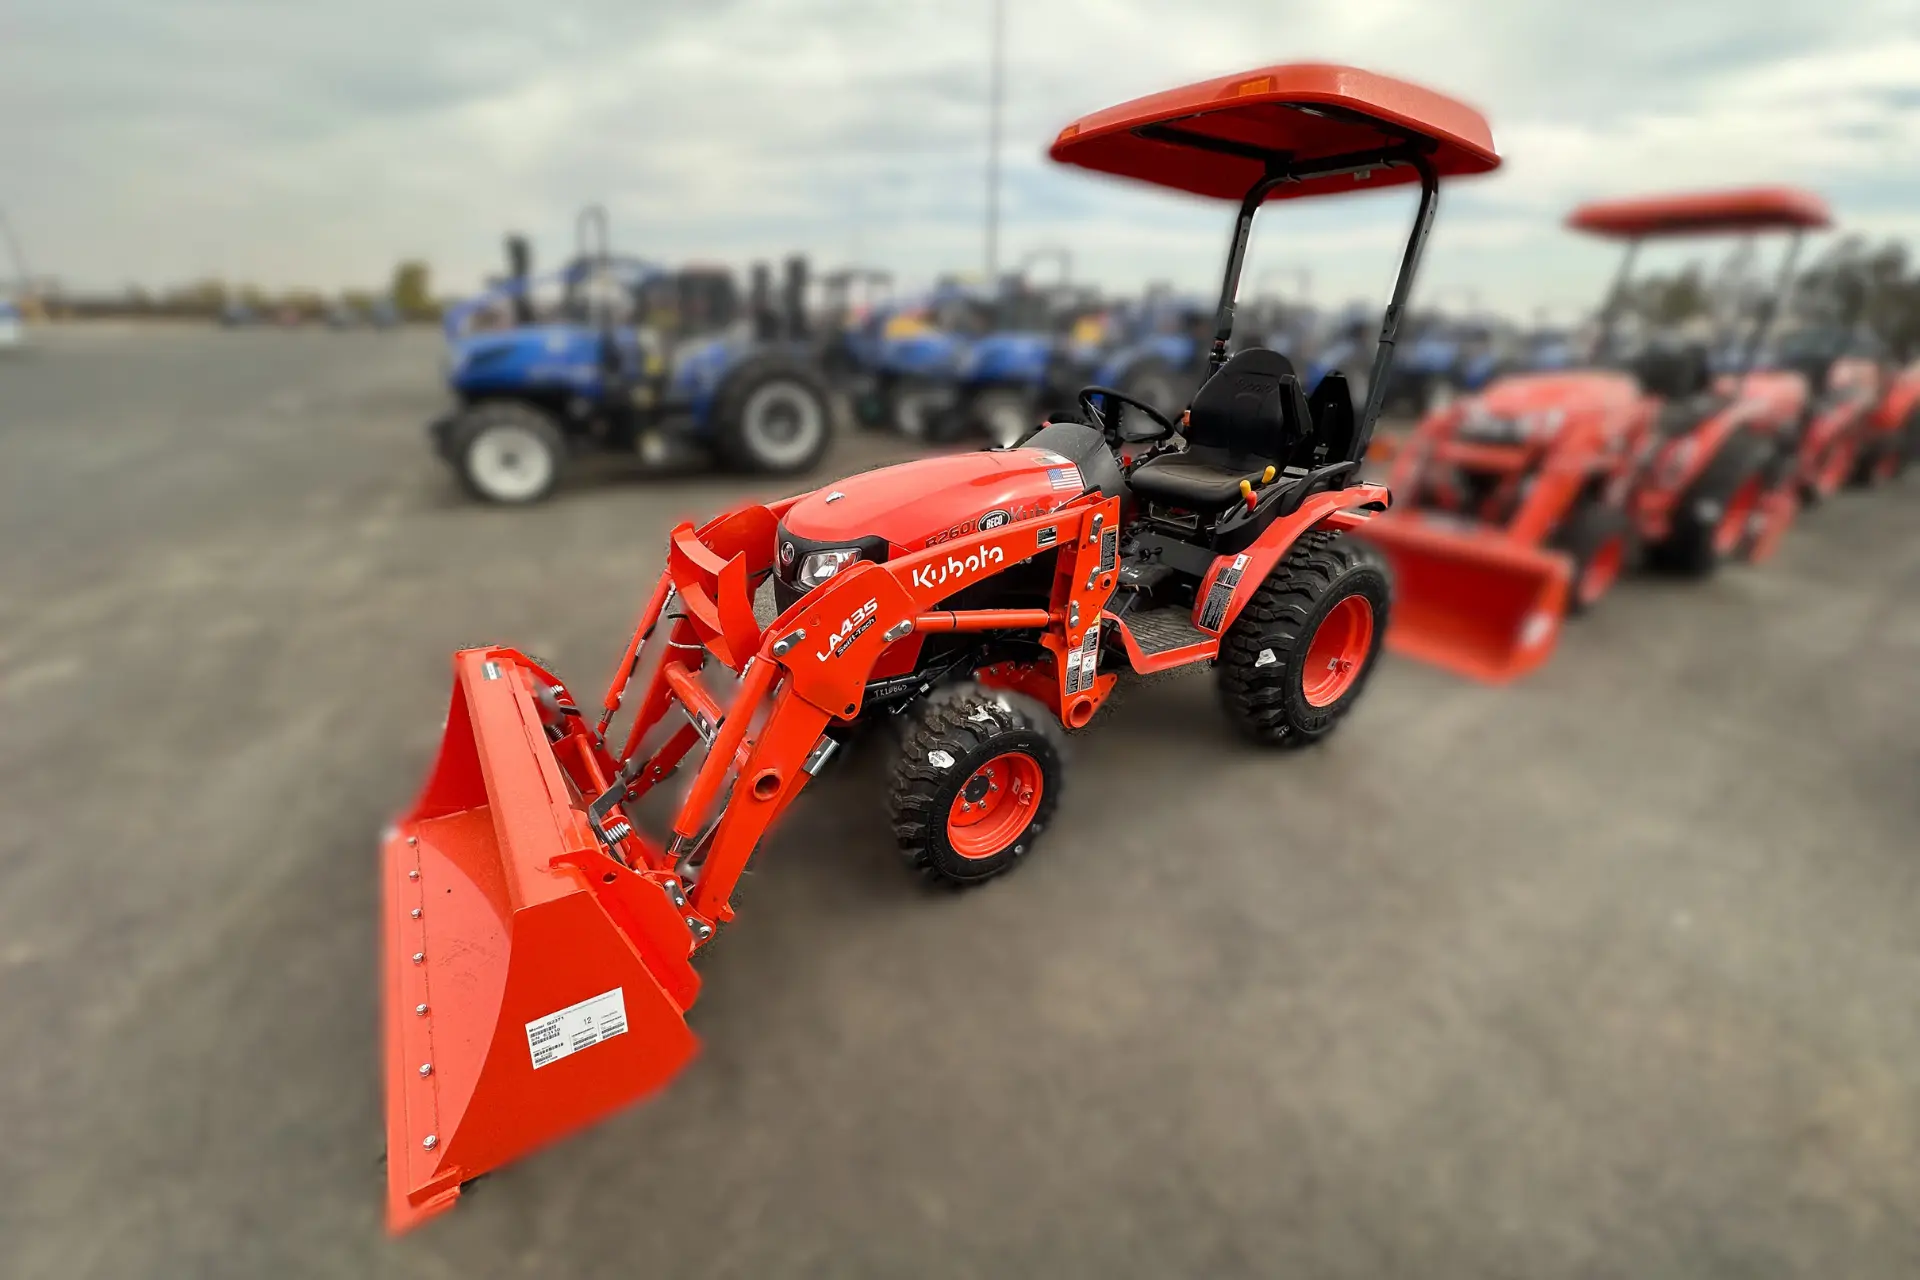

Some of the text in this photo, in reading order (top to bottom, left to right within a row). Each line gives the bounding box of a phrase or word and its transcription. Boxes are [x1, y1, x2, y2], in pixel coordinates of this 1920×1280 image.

[986, 515, 1003, 530] BECO
[912, 545, 1004, 589] Kubota
[816, 597, 878, 662] LA435
[837, 618, 875, 656] Swift-Tach
